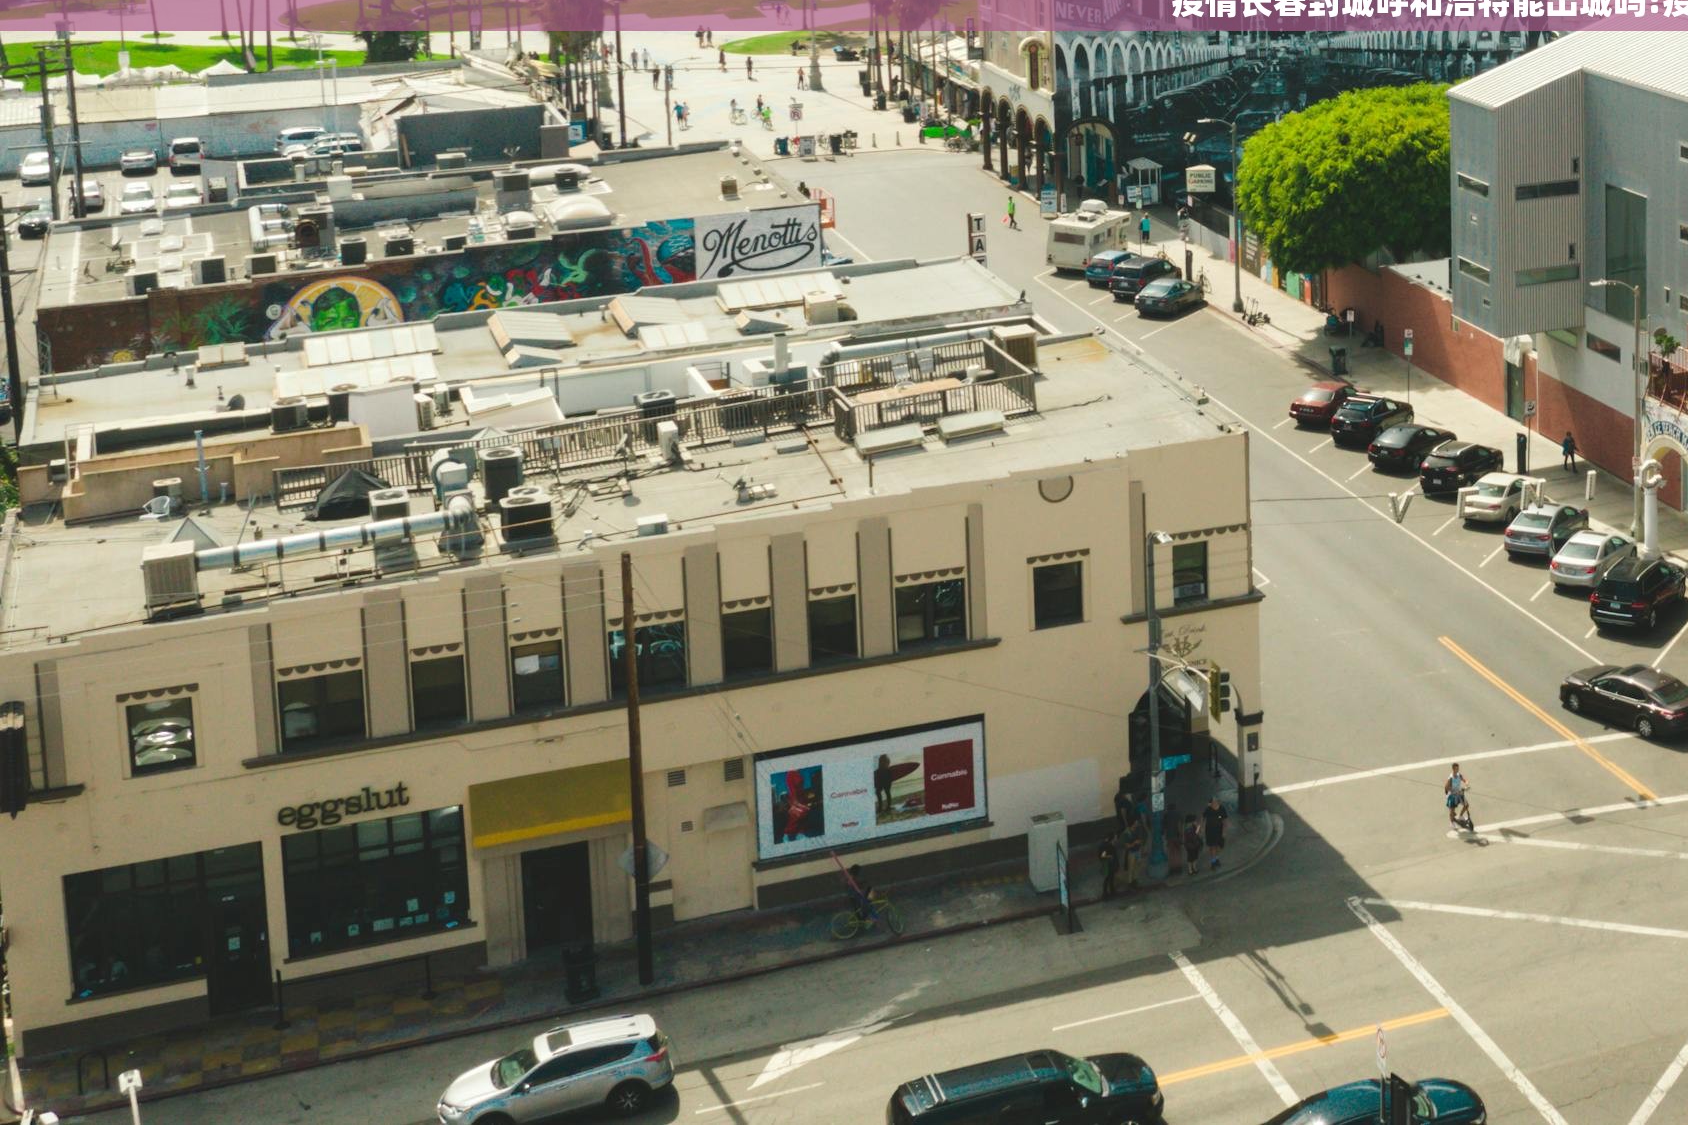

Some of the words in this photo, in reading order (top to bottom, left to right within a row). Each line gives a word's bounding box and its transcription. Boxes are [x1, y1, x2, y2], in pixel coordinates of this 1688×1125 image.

[930, 768, 969, 782] Cannabis
[830, 786, 868, 799] Cannabis
[277, 781, 410, 830] eggslut
